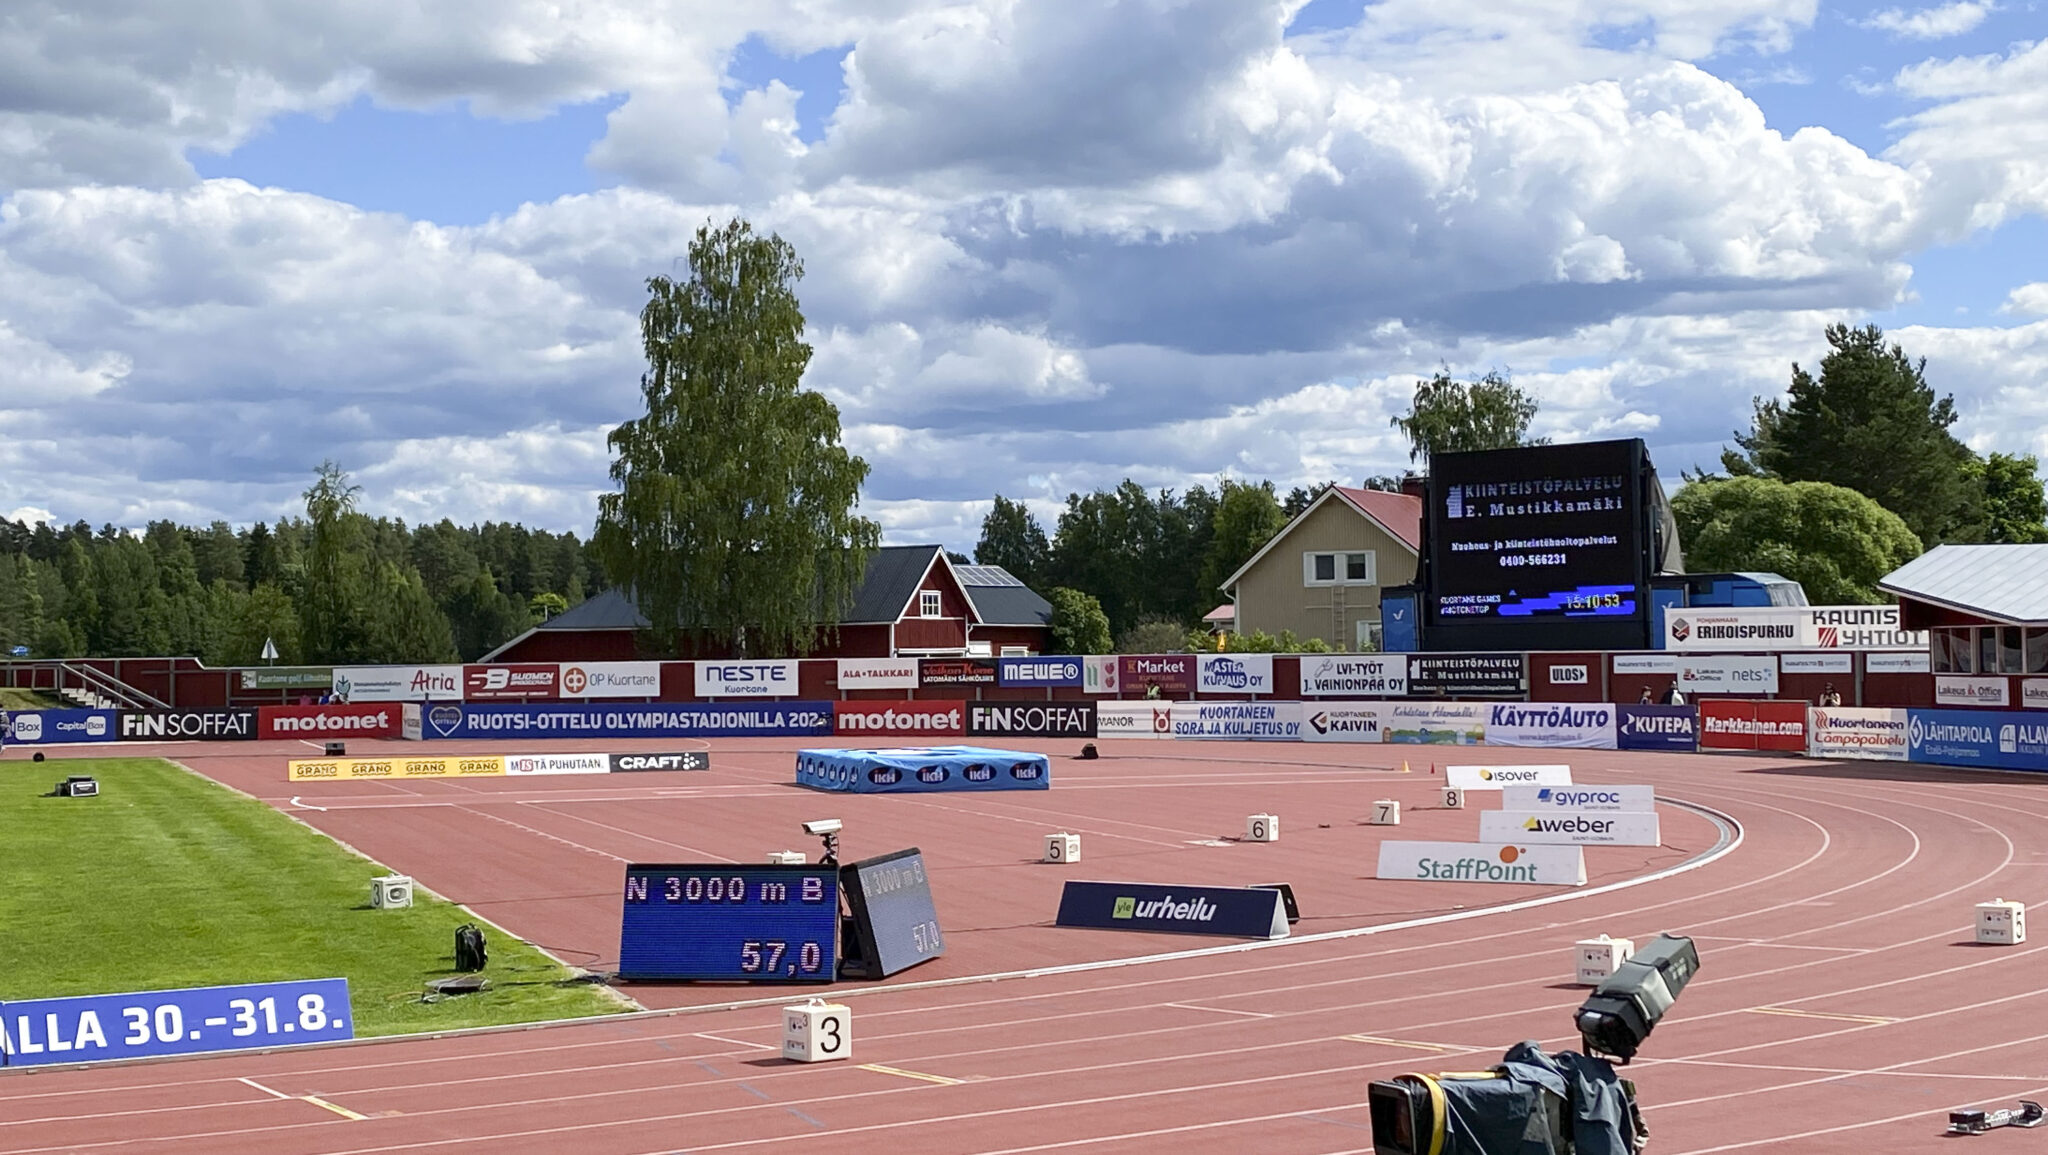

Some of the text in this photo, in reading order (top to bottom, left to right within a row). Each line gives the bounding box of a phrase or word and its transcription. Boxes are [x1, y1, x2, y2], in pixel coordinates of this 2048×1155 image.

[1465, 475, 1623, 498] KIINTEISTÖPALVELU
[1466, 497, 1623, 517] E. Mustikkamäki
[1499, 553, 1567, 566] 0400-566231
[1812, 610, 1898, 625] KAUNIS
[1697, 625, 1795, 639] ERIKOISPURKU
[1204, 660, 1244, 673] MASTER
[1336, 660, 1384, 675] LVI-TYÖT
[1421, 658, 1520, 668] KIINTEISTÖPALVELU
[410, 670, 456, 692] Atria
[589, 673, 655, 686] OP Kuortane
[1203, 674, 1263, 686] KUIVAUS OY
[1552, 668, 1578, 681] ULOS
[1732, 669, 1763, 681] nets
[724, 685, 768, 693] Kuortane
[1304, 679, 1312, 692] J.
[1315, 676, 1385, 691] VAINIONPÄÄ
[1389, 678, 1404, 691] OY
[839, 708, 961, 730] motonet
[1200, 706, 1275, 719] KUORTANEEN
[17, 722, 40, 732] Box
[273, 710, 389, 731] motonet
[468, 711, 827, 730] RUOTSI-OTTELU OLYMPIASTADIONILLA 202
[1330, 720, 1377, 731] KAIVIN
[1635, 716, 1693, 734] KUTEPA
[1704, 716, 1803, 736] Karkkainen.com
[1829, 717, 1904, 729] Kuortaneen
[1175, 722, 1300, 735] SORA JA KULJETUS OY
[1925, 721, 1993, 743] LÄHITAPIOLA
[1814, 732, 1906, 747] Lämpöpalvelu
[297, 762, 498, 775] GRANO GRANO GRANO GRANO
[511, 757, 546, 772] MISTÄ
[619, 756, 682, 769] CRAFT
[1494, 771, 1539, 780] isover
[1446, 791, 1457, 806] 8
[1555, 791, 1620, 805] gyproc
[1379, 806, 1389, 822] 7
[1253, 821, 1264, 838] 6
[1542, 816, 1615, 833] weber
[1050, 840, 1060, 859] 5
[1416, 857, 1538, 882] StaffPoint
[626, 877, 823, 900] N 3000 m B
[873, 867, 901, 895] 3000
[374, 884, 380, 905] 3
[1116, 895, 1218, 921] yle urheilu
[912, 921, 940, 953] 57,0
[741, 942, 820, 977] 57,0
[821, 1016, 841, 1053] 3
